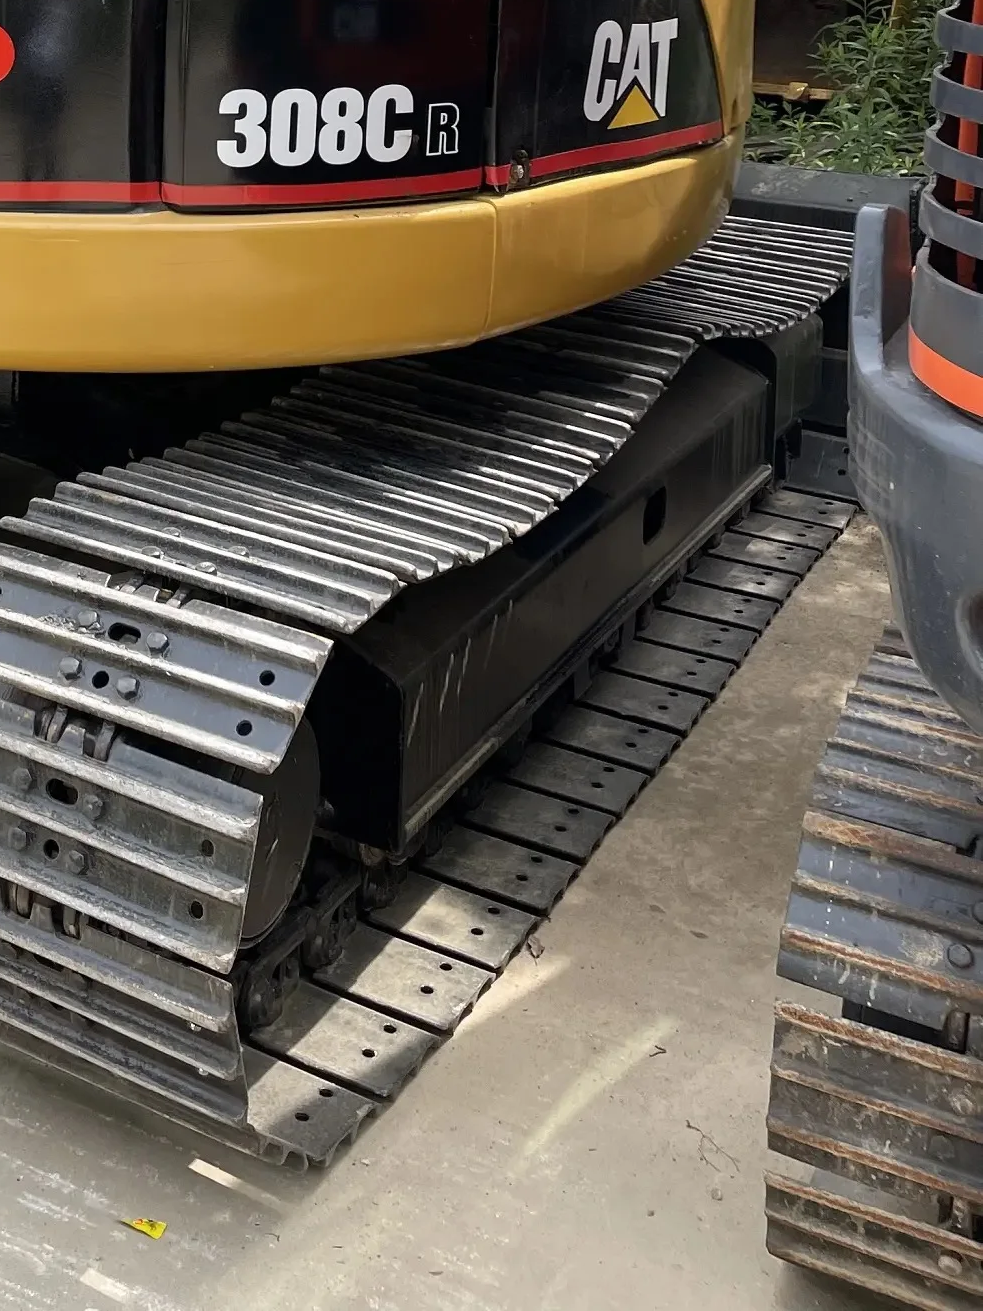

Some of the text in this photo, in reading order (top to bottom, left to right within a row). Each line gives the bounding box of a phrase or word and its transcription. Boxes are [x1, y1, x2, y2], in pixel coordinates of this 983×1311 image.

[584, 18, 678, 122] CAT
[217, 84, 459, 167] 308C R
